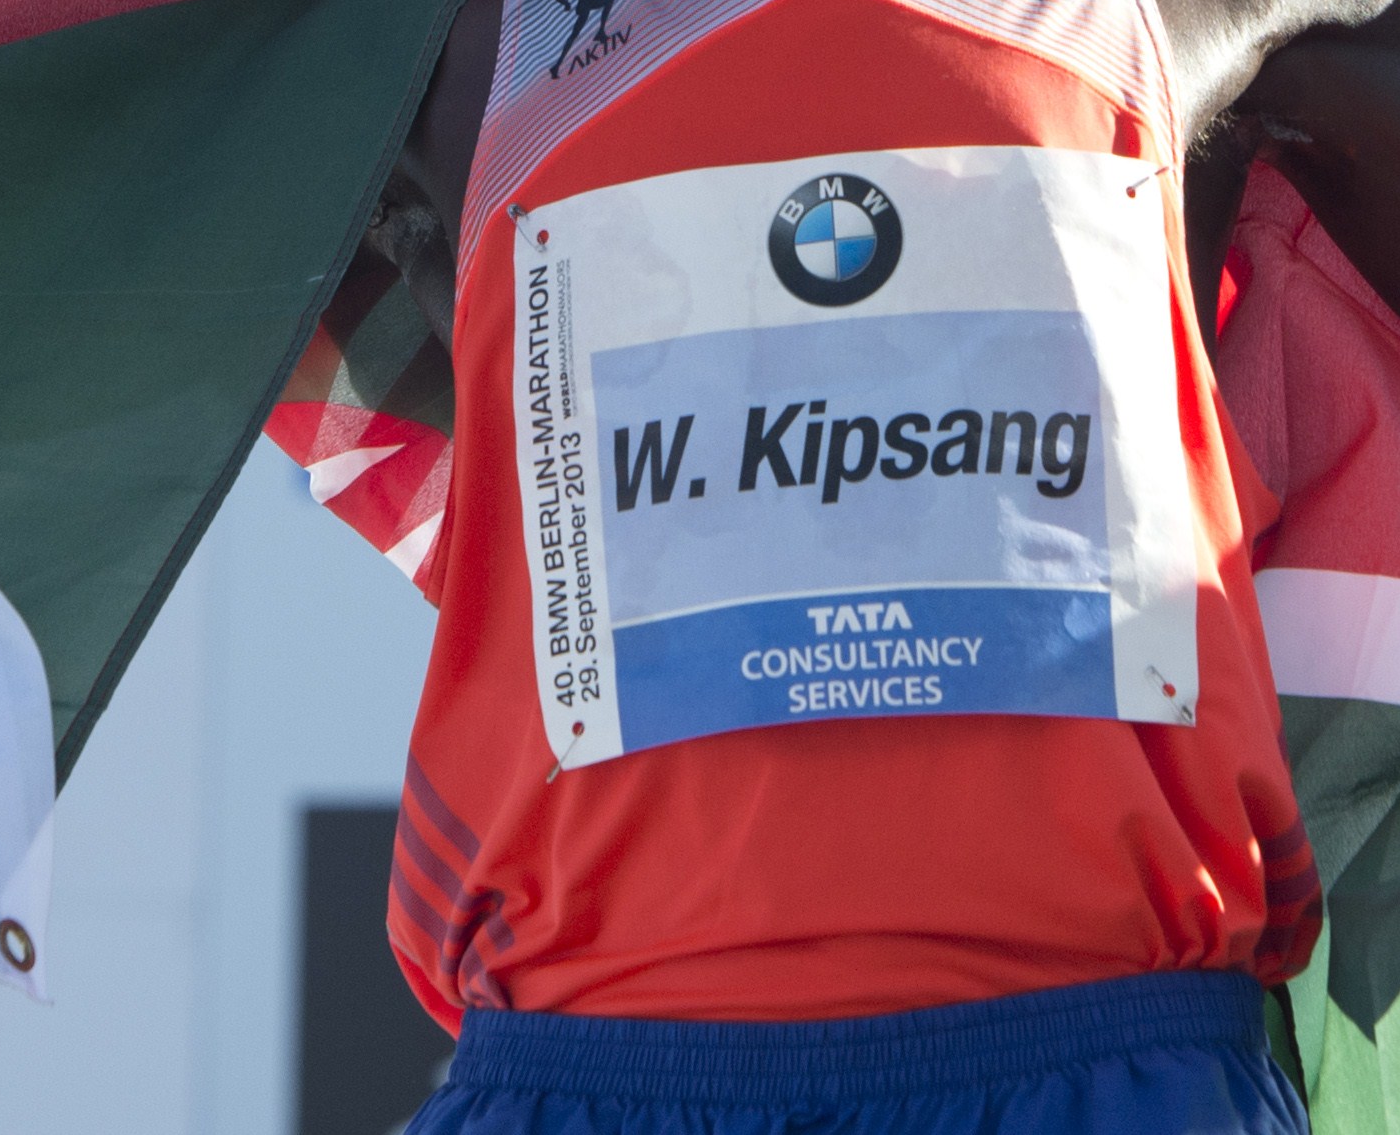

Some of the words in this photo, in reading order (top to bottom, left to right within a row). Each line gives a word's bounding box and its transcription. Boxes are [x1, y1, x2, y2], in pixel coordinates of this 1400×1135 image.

[568, 23, 632, 75] AKTIV
[778, 176, 890, 226] BMW
[529, 265, 564, 573] BERLIN-MARATHON
[560, 431, 585, 498] 2013
[613, 414, 707, 512] W.
[738, 400, 1092, 505] Kipsang
[569, 504, 597, 655] September
[546, 579, 571, 658] BMW
[807, 601, 913, 635] TATA
[555, 661, 576, 708] 40.
[579, 658, 601, 703] 29.
[741, 637, 983, 681] CONSULTANCY
[788, 675, 943, 713] SERVICES
